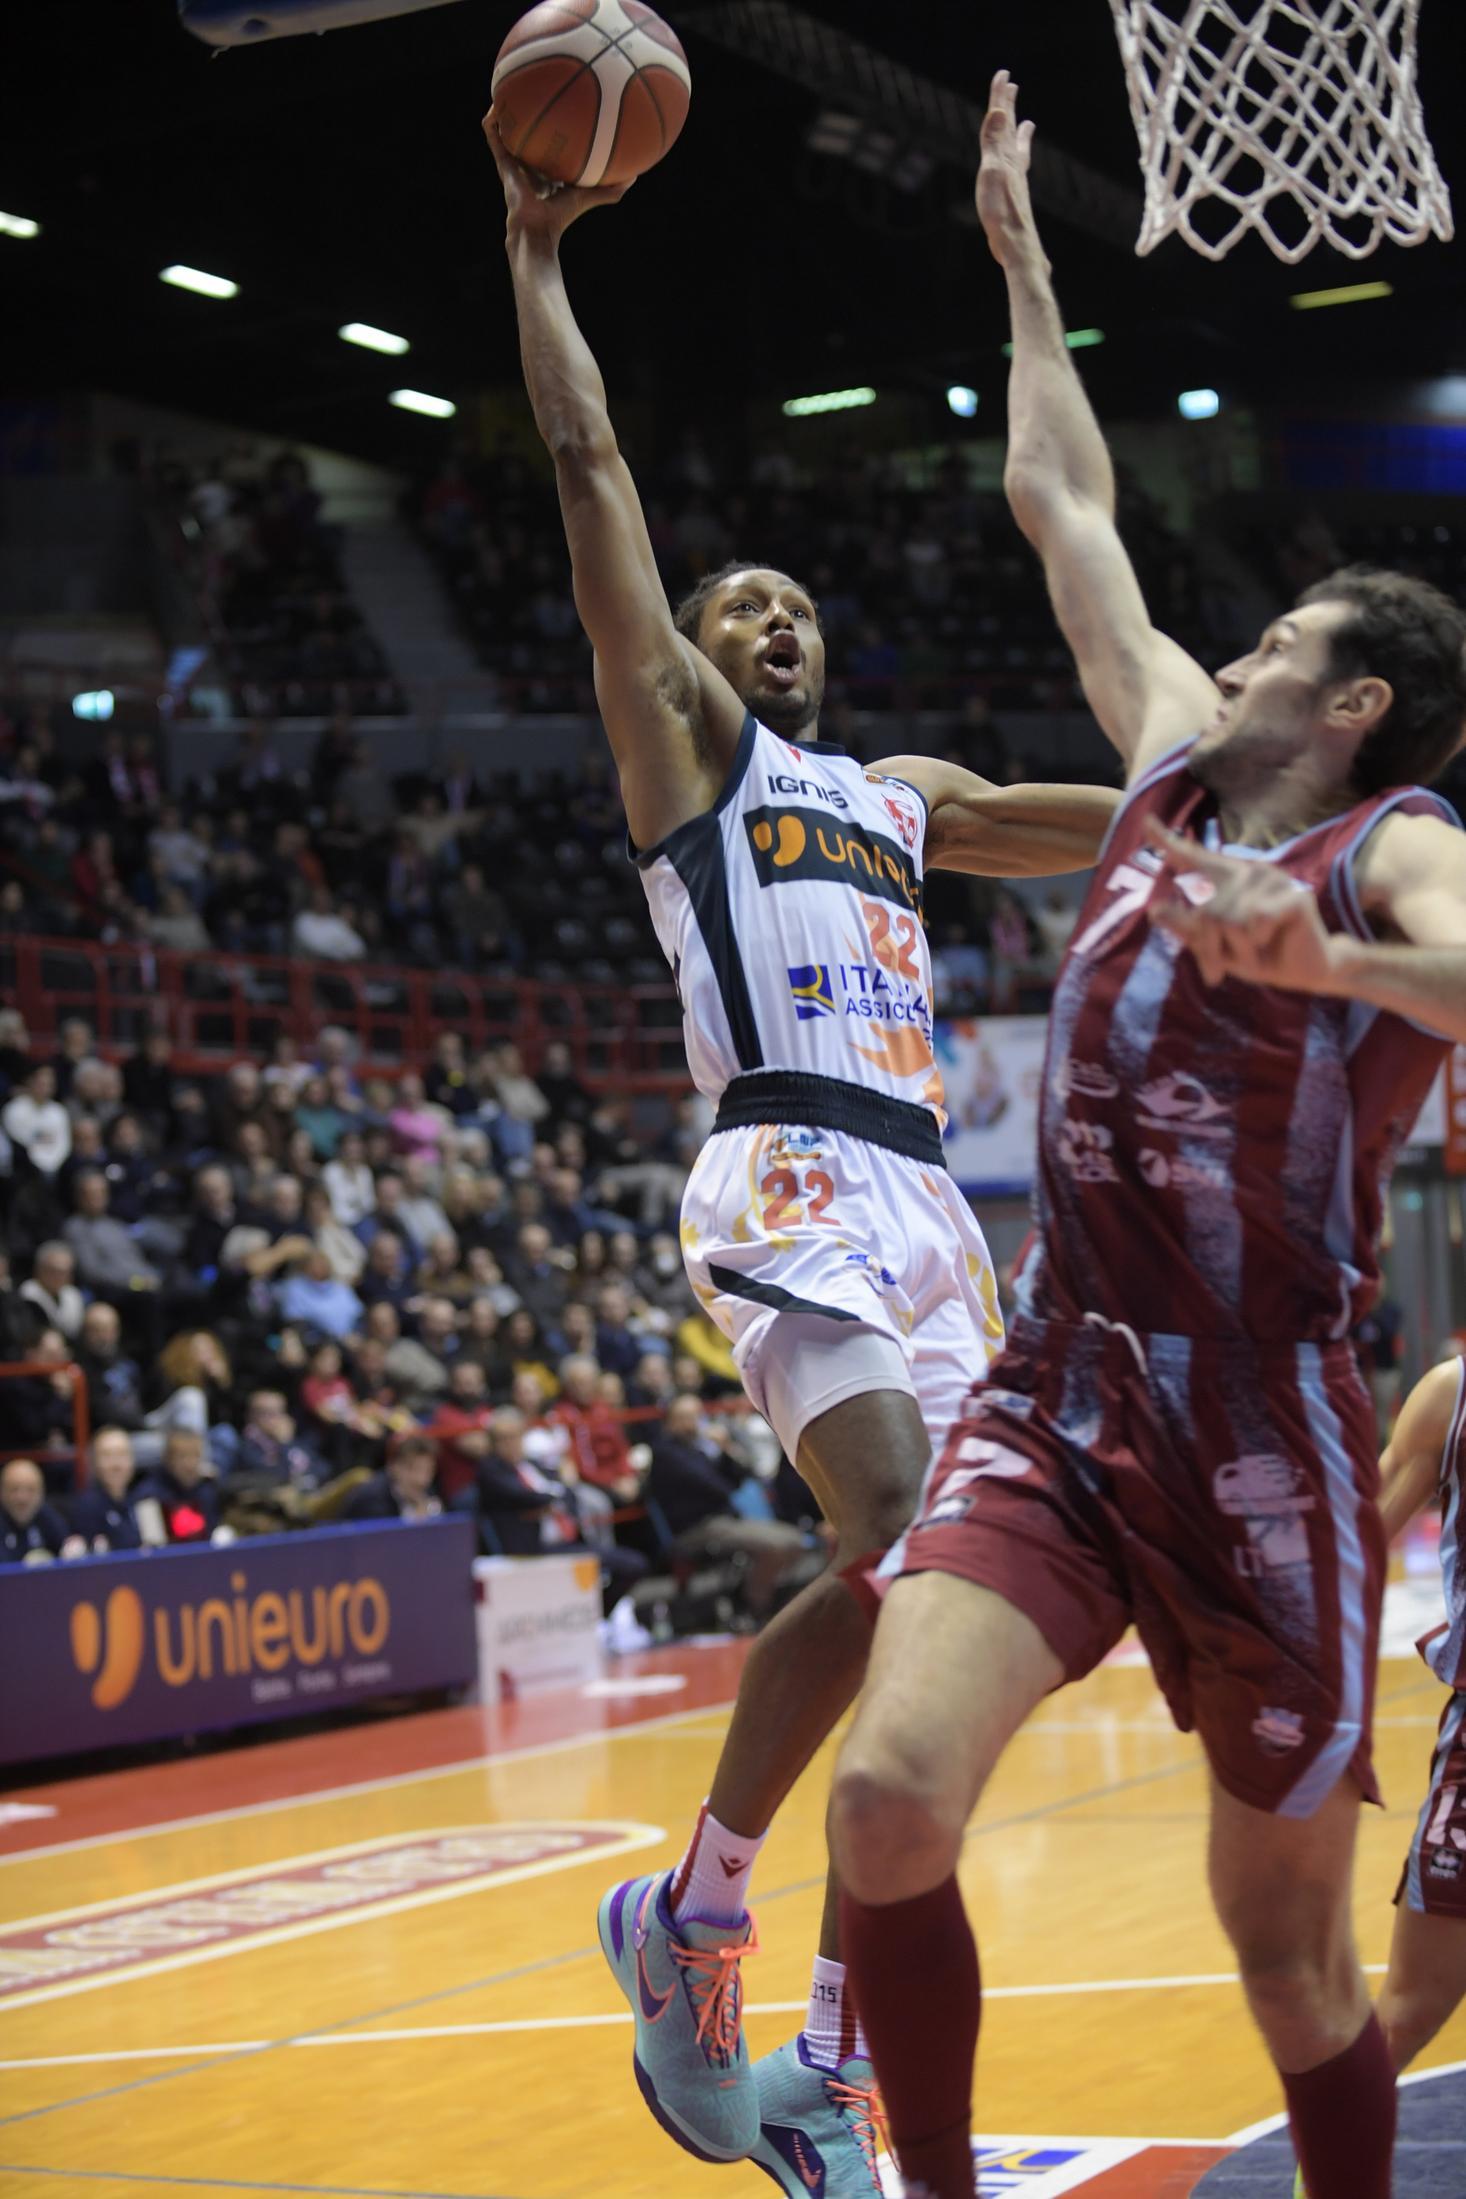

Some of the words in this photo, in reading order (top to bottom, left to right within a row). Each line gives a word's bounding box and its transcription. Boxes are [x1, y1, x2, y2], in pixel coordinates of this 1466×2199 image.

[861, 901, 920, 982] 22
[761, 1169, 842, 1231] 22
[153, 1571, 391, 1686] unieuro
